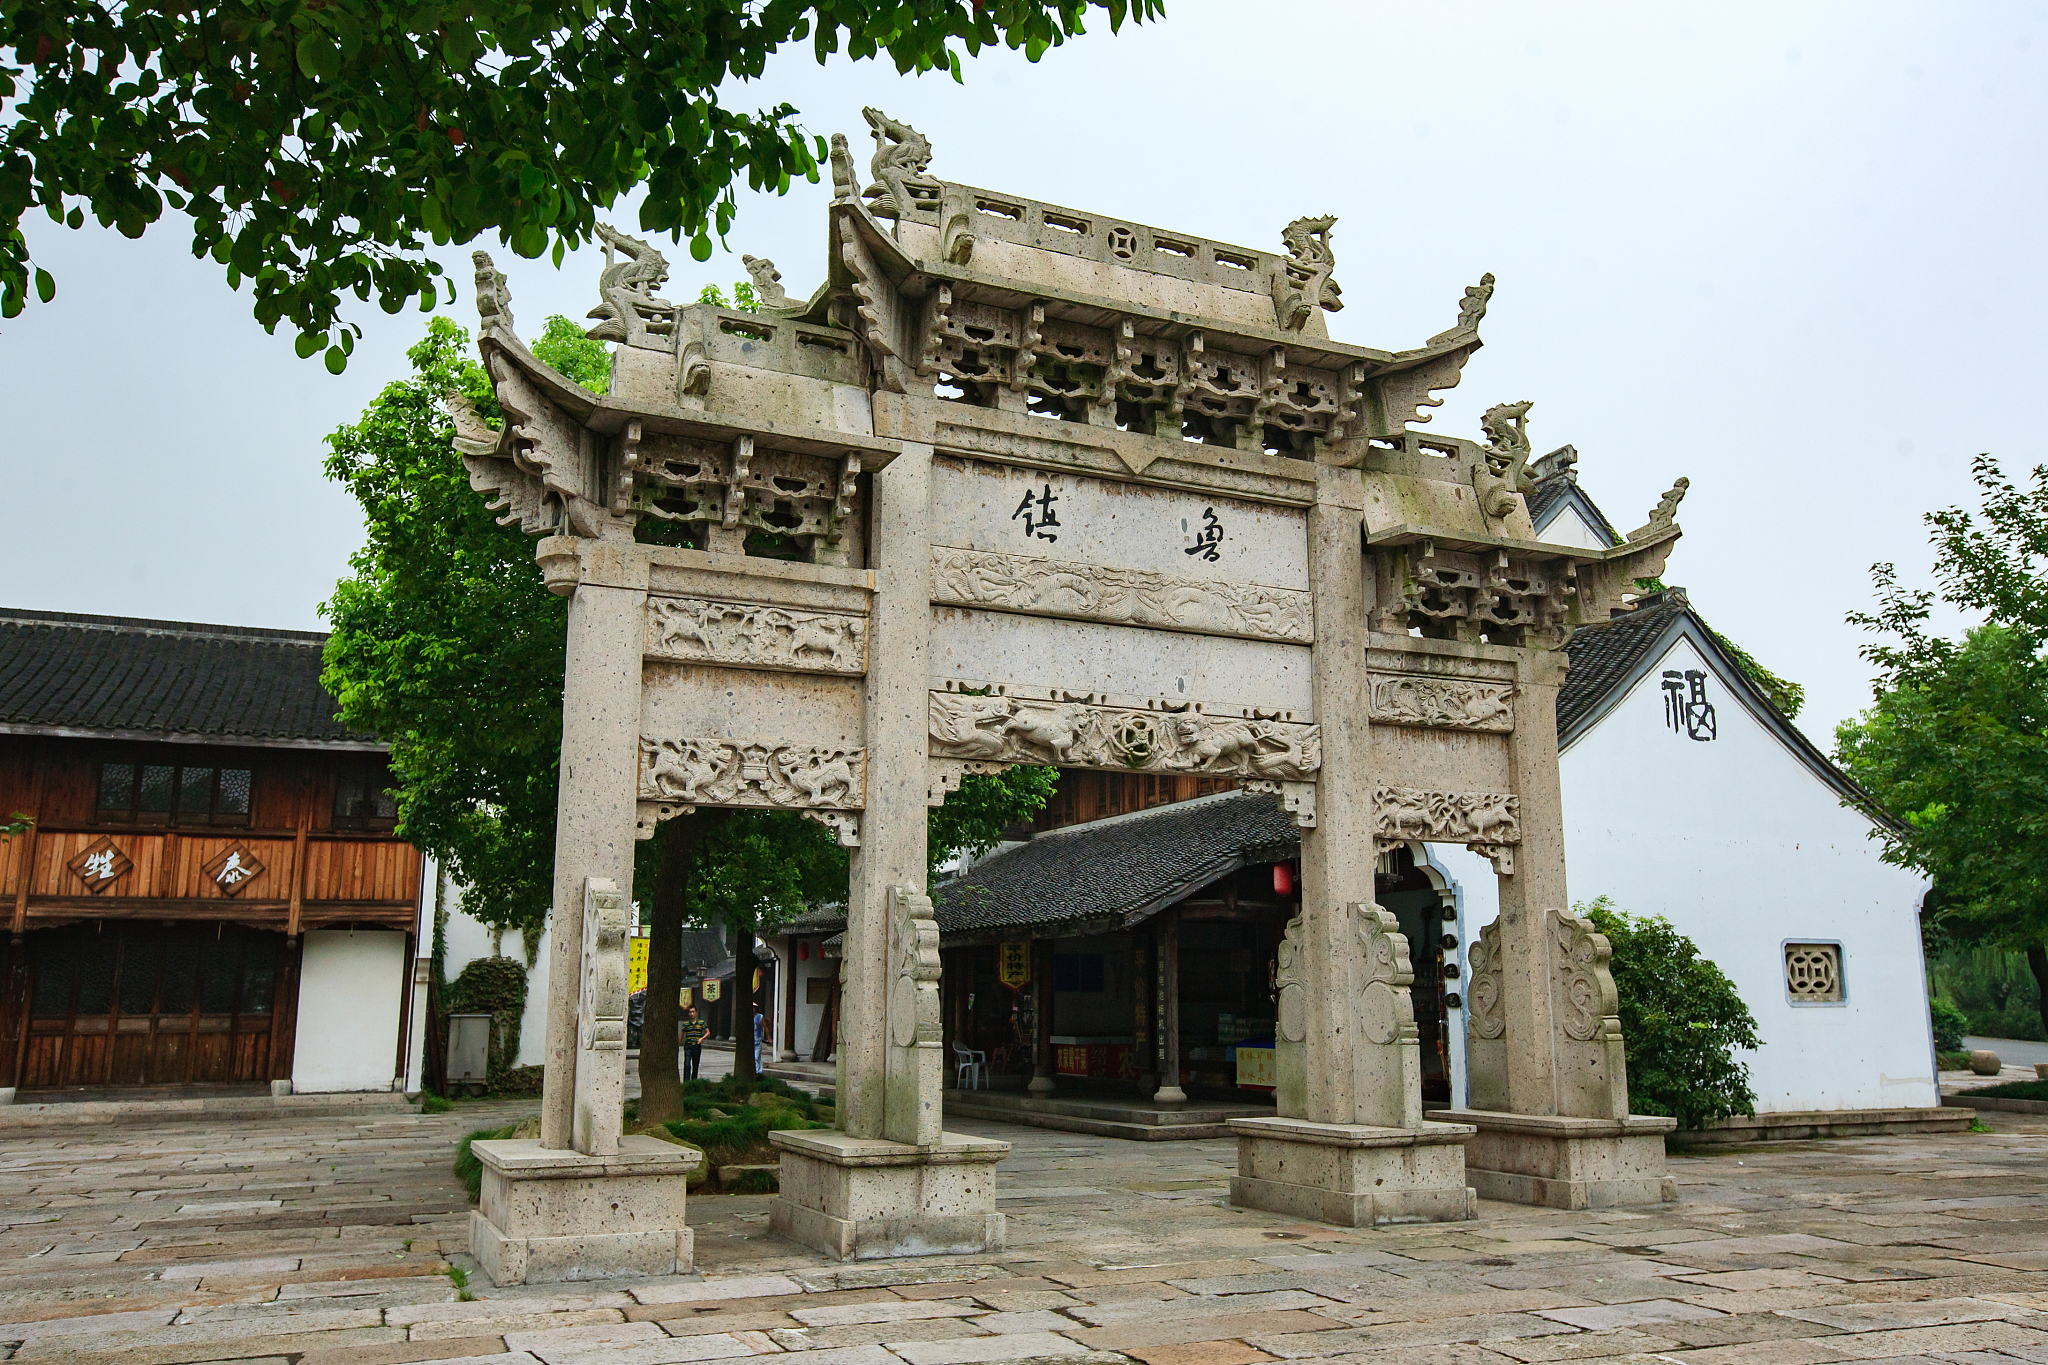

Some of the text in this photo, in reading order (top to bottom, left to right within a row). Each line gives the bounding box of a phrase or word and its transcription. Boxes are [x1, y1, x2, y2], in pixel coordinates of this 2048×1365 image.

[1661, 669, 1717, 742] 福
[216, 851, 252, 884] 泰
[1006, 944, 1024, 979] 平价特产
[706, 983, 716, 994] 茶
[1134, 949, 1147, 1052] 平价特产
[1257, 1050, 1265, 1084] 矿泉水
